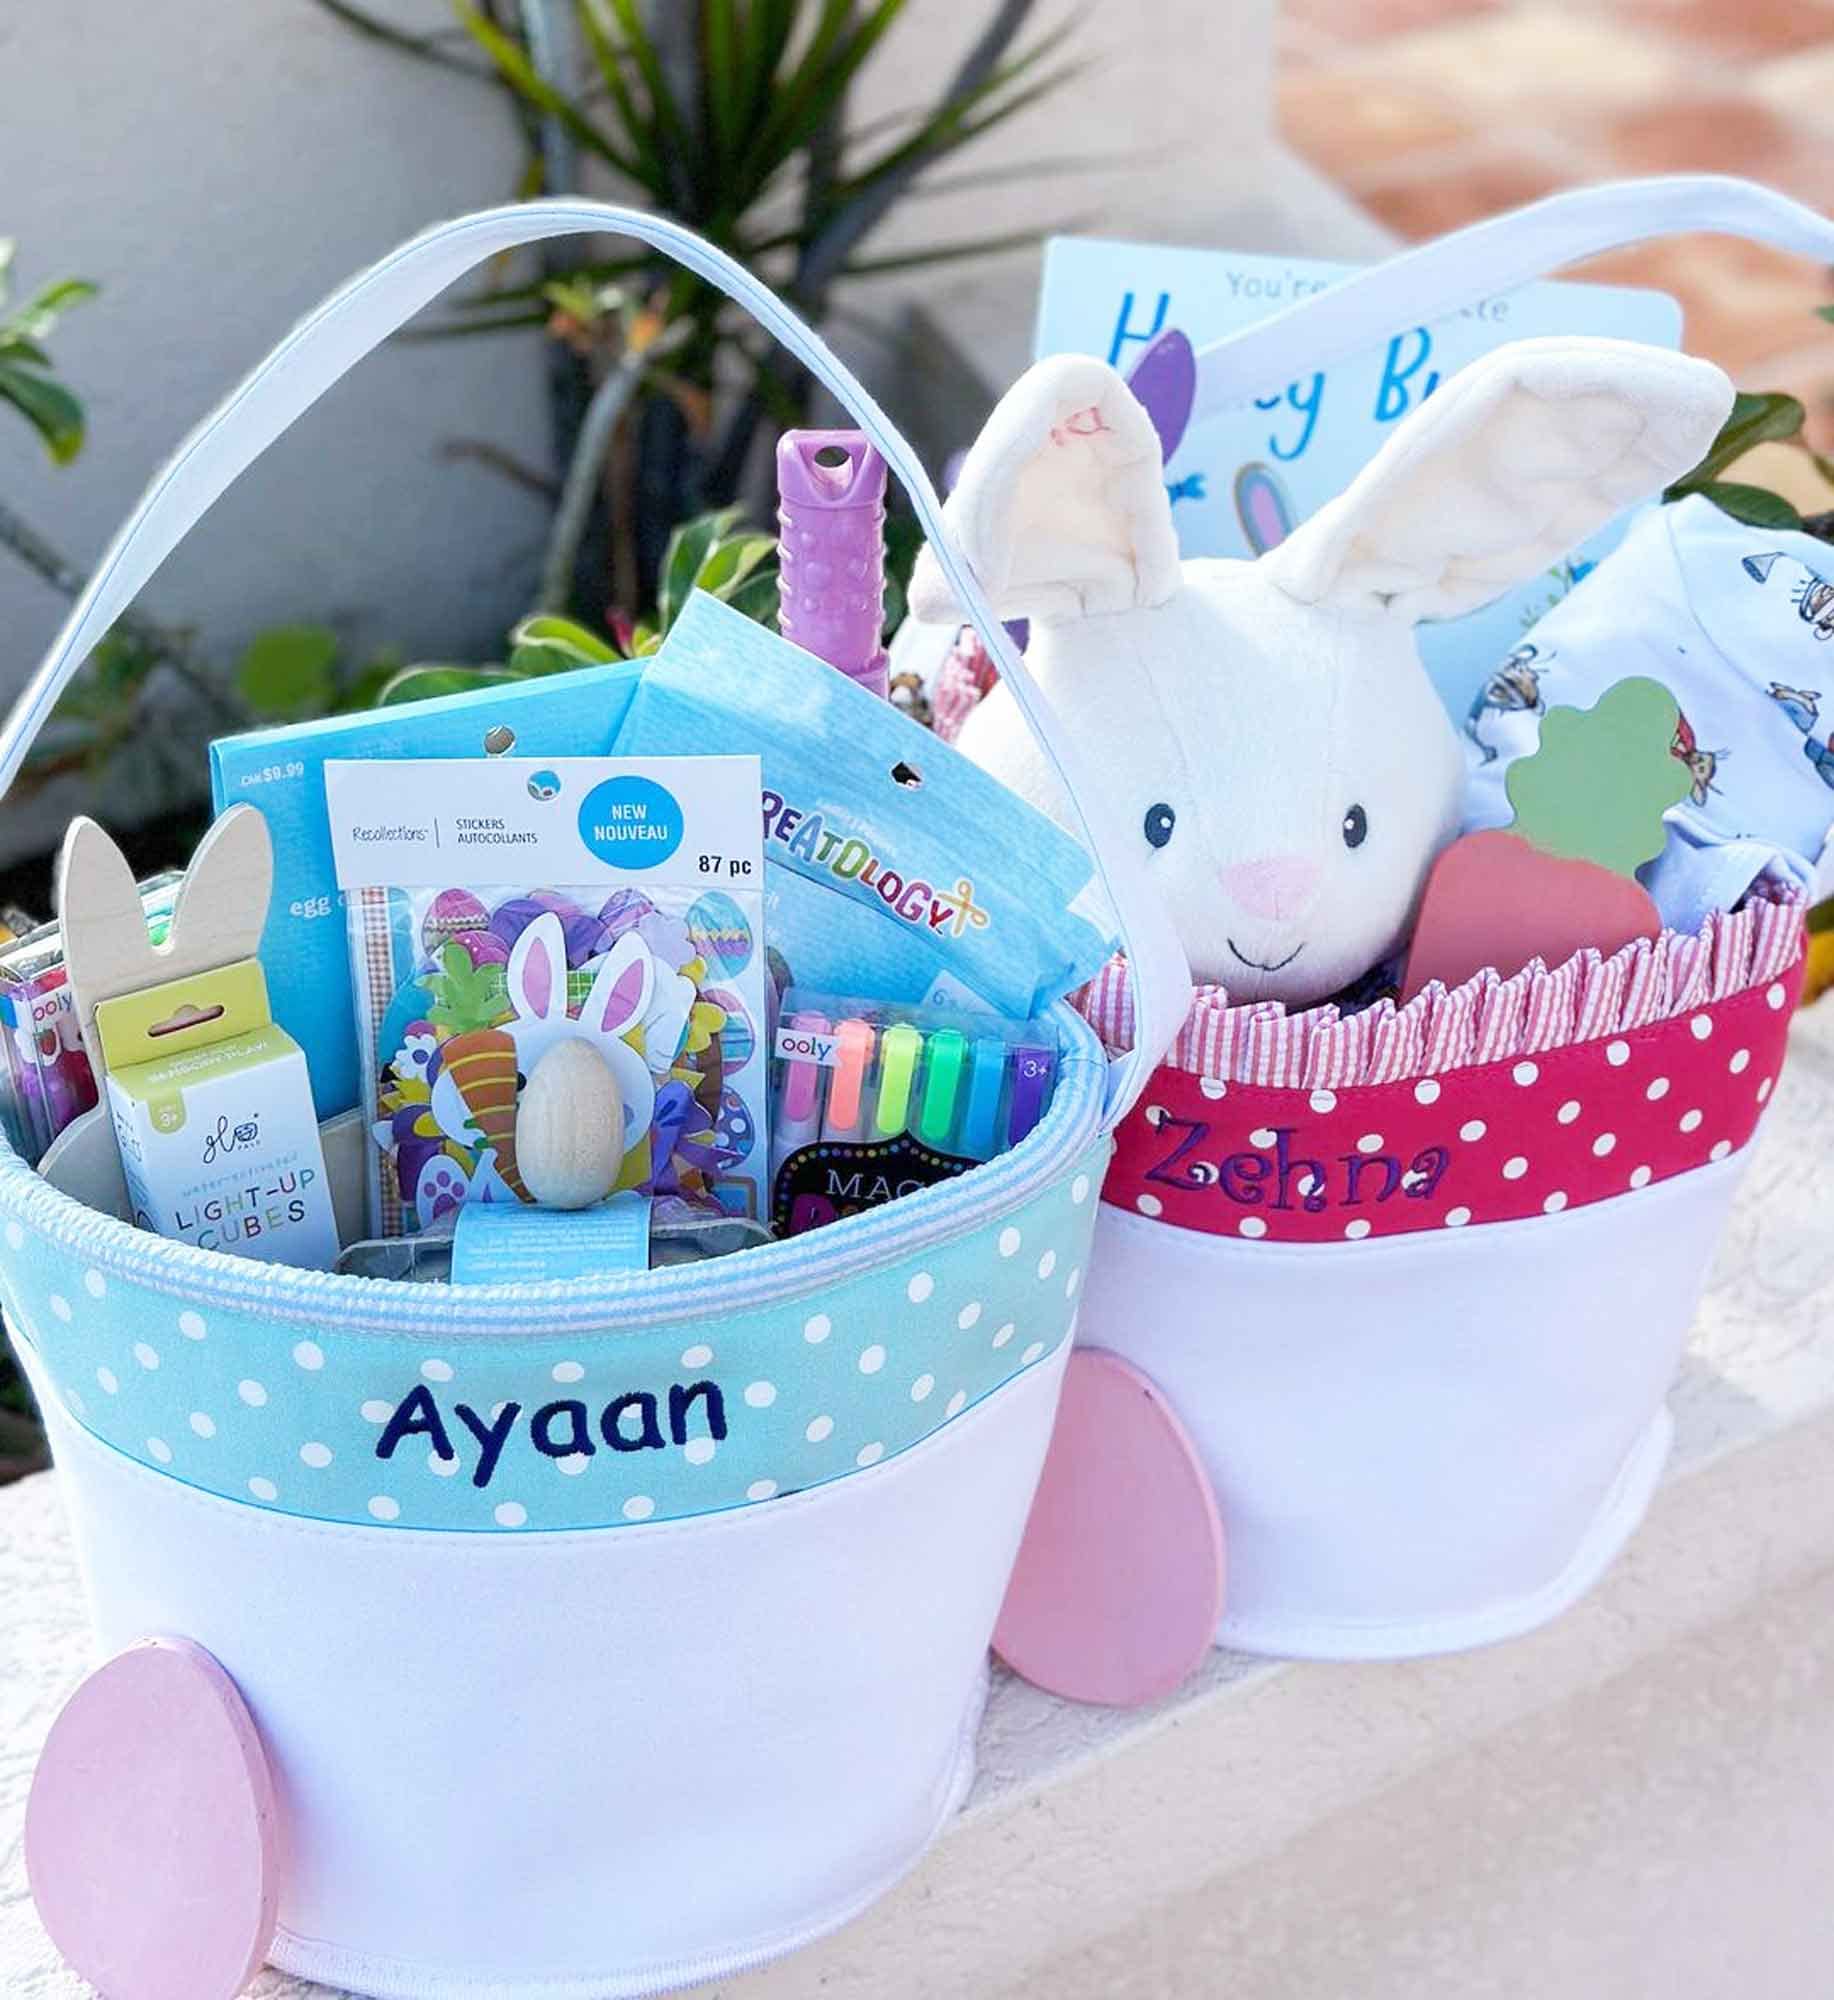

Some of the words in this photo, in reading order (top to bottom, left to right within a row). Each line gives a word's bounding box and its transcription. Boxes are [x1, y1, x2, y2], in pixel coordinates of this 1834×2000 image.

[455, 818, 505, 830] STICKERS
[612, 804, 647, 820] NEW
[352, 825, 425, 842] Recollections
[457, 832, 538, 845] AUTOCOLLANTS
[594, 825, 668, 841] NOUVEAU
[699, 855, 722, 873] 87
[729, 858, 752, 877] pc
[762, 789, 954, 930] REATOLOGY
[289, 895, 332, 919] egg
[32, 991, 73, 1021] ooly
[781, 1036, 832, 1061] ooly
[1022, 1059, 1048, 1078] 3+
[1144, 1110, 1449, 1213] Zehna
[175, 1168, 315, 1231] LIGHT-UP
[197, 1200, 305, 1250] CUBES
[375, 1380, 727, 1488] Ayaan
